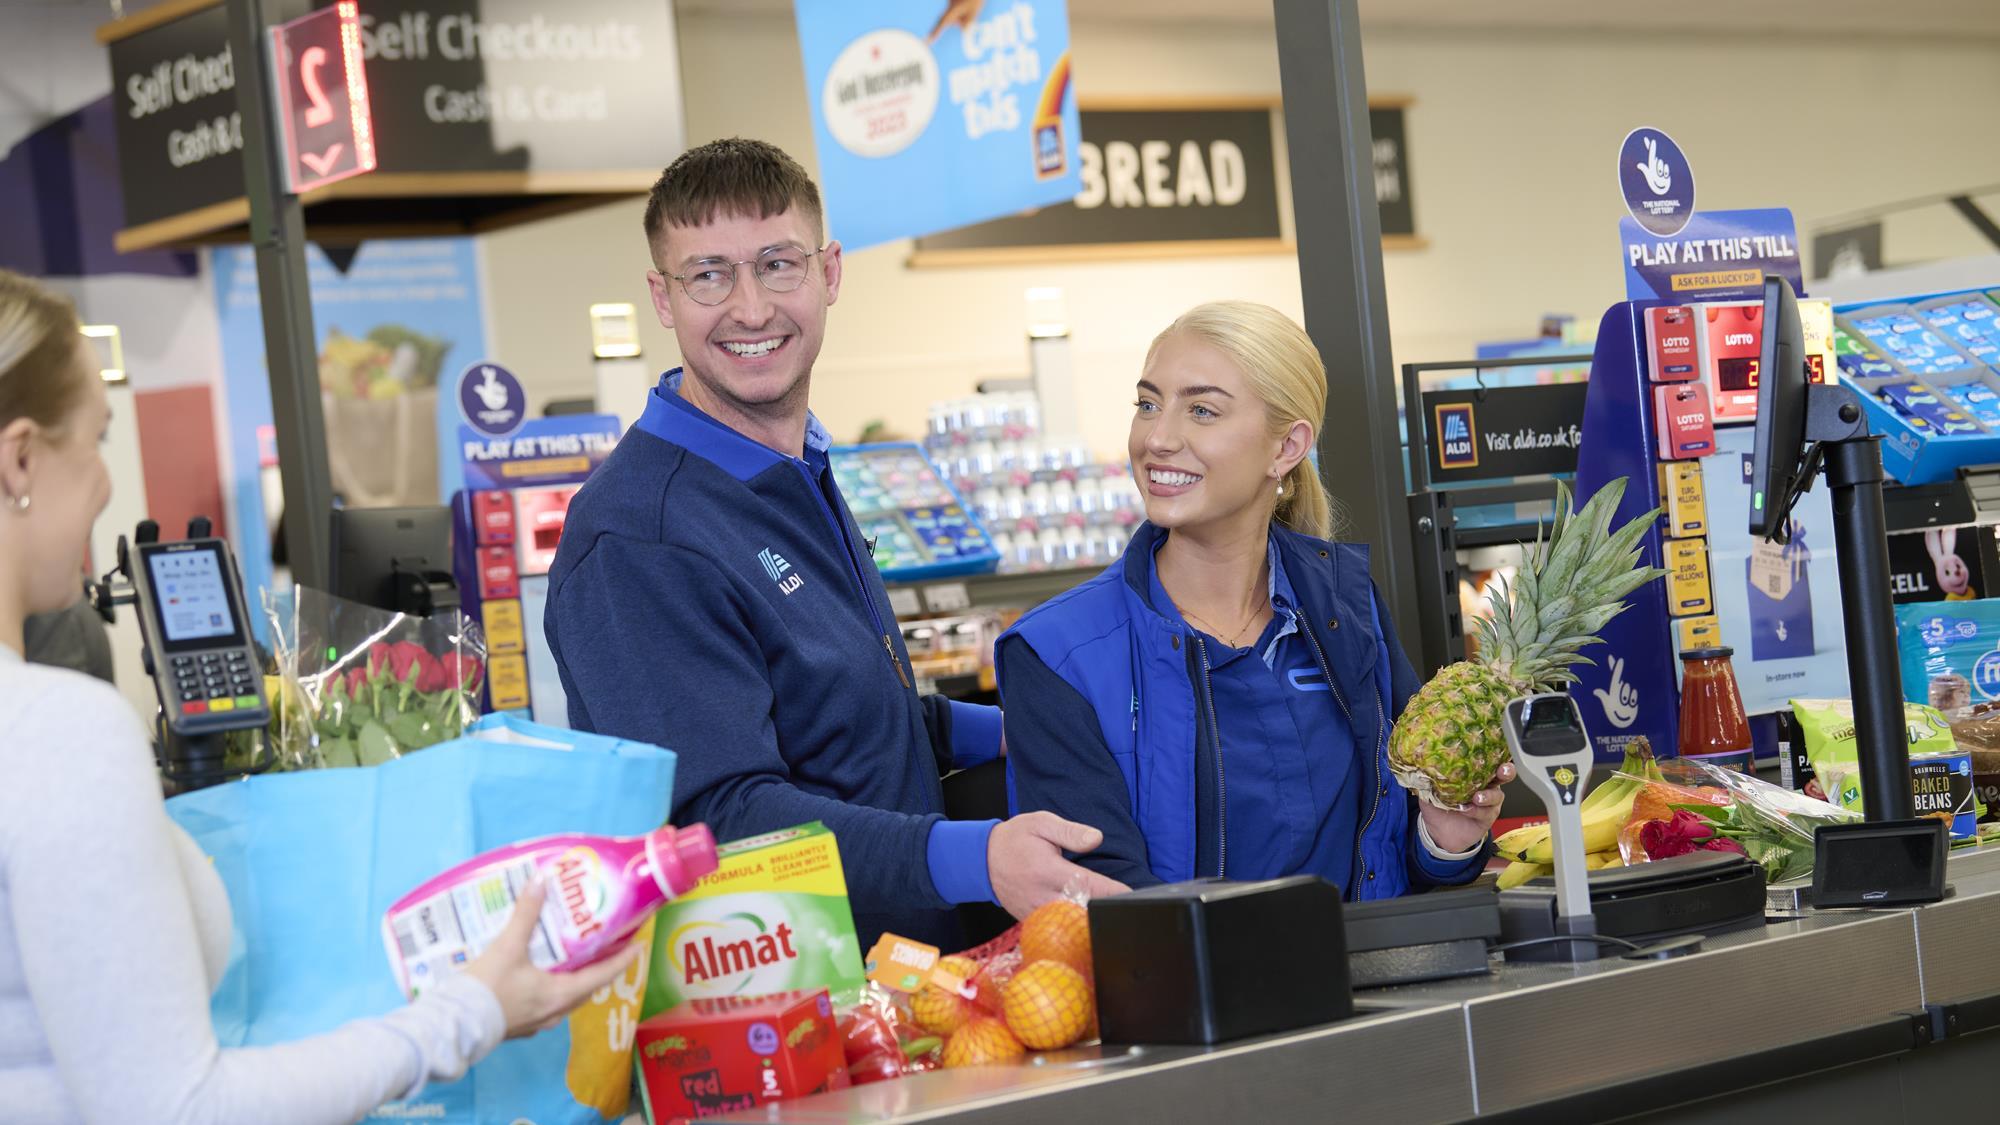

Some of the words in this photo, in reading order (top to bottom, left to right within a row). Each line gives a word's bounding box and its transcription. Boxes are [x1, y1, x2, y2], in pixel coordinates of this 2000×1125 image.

[359, 12, 430, 60] Self
[437, 12, 643, 61] Checkouts
[126, 60, 172, 119] Self
[424, 84, 502, 123] Cash
[505, 84, 531, 122] &
[534, 84, 608, 122] Card
[168, 120, 215, 167] Cash
[1073, 140, 1246, 208] BREAD
[1654, 199, 1680, 207] NATIONAL
[1629, 241, 1679, 267] PLAY
[1683, 239, 1706, 264] AT
[1707, 237, 1752, 261] THIS
[1754, 235, 1794, 258] TILL
[1677, 276, 1694, 287] ASK
[1695, 275, 1710, 286] FOR
[1711, 275, 1717, 284] A
[1718, 273, 1743, 284] LUCKY
[1744, 271, 1757, 282] DIP
[1663, 337, 1689, 347] LOTTO
[1725, 333, 1753, 345] LOTTO
[1677, 413, 1704, 425] LOTTO
[464, 440, 511, 461] PLAY
[512, 437, 536, 457] AT
[536, 434, 581, 456] THIS
[1485, 432, 1511, 451] Visit
[1513, 426, 1569, 450] aldi.co.uk
[1446, 442, 1471, 455] ALDI
[1675, 571, 1704, 581] MILLIONS
[1680, 564, 1696, 572] EURO
[778, 572, 804, 596] ALDI
[1931, 618, 1944, 636] 5
[1765, 672, 1792, 683] In-store
[1792, 671, 1806, 679] now
[1596, 736, 1610, 744] THE
[1914, 765, 1946, 775] BRAMWELLS
[1912, 776, 1950, 793] BAKED
[1913, 793, 1952, 810] BEANS
[770, 844, 827, 864] BRILLIANTLY
[772, 860, 801, 873] CLEAN
[804, 854, 829, 866] WITH
[703, 863, 764, 887] FORMULA
[556, 859, 604, 938] Almat
[683, 922, 797, 985] Almat
[683, 1069, 719, 1096] red
[762, 1069, 777, 1091] 5
